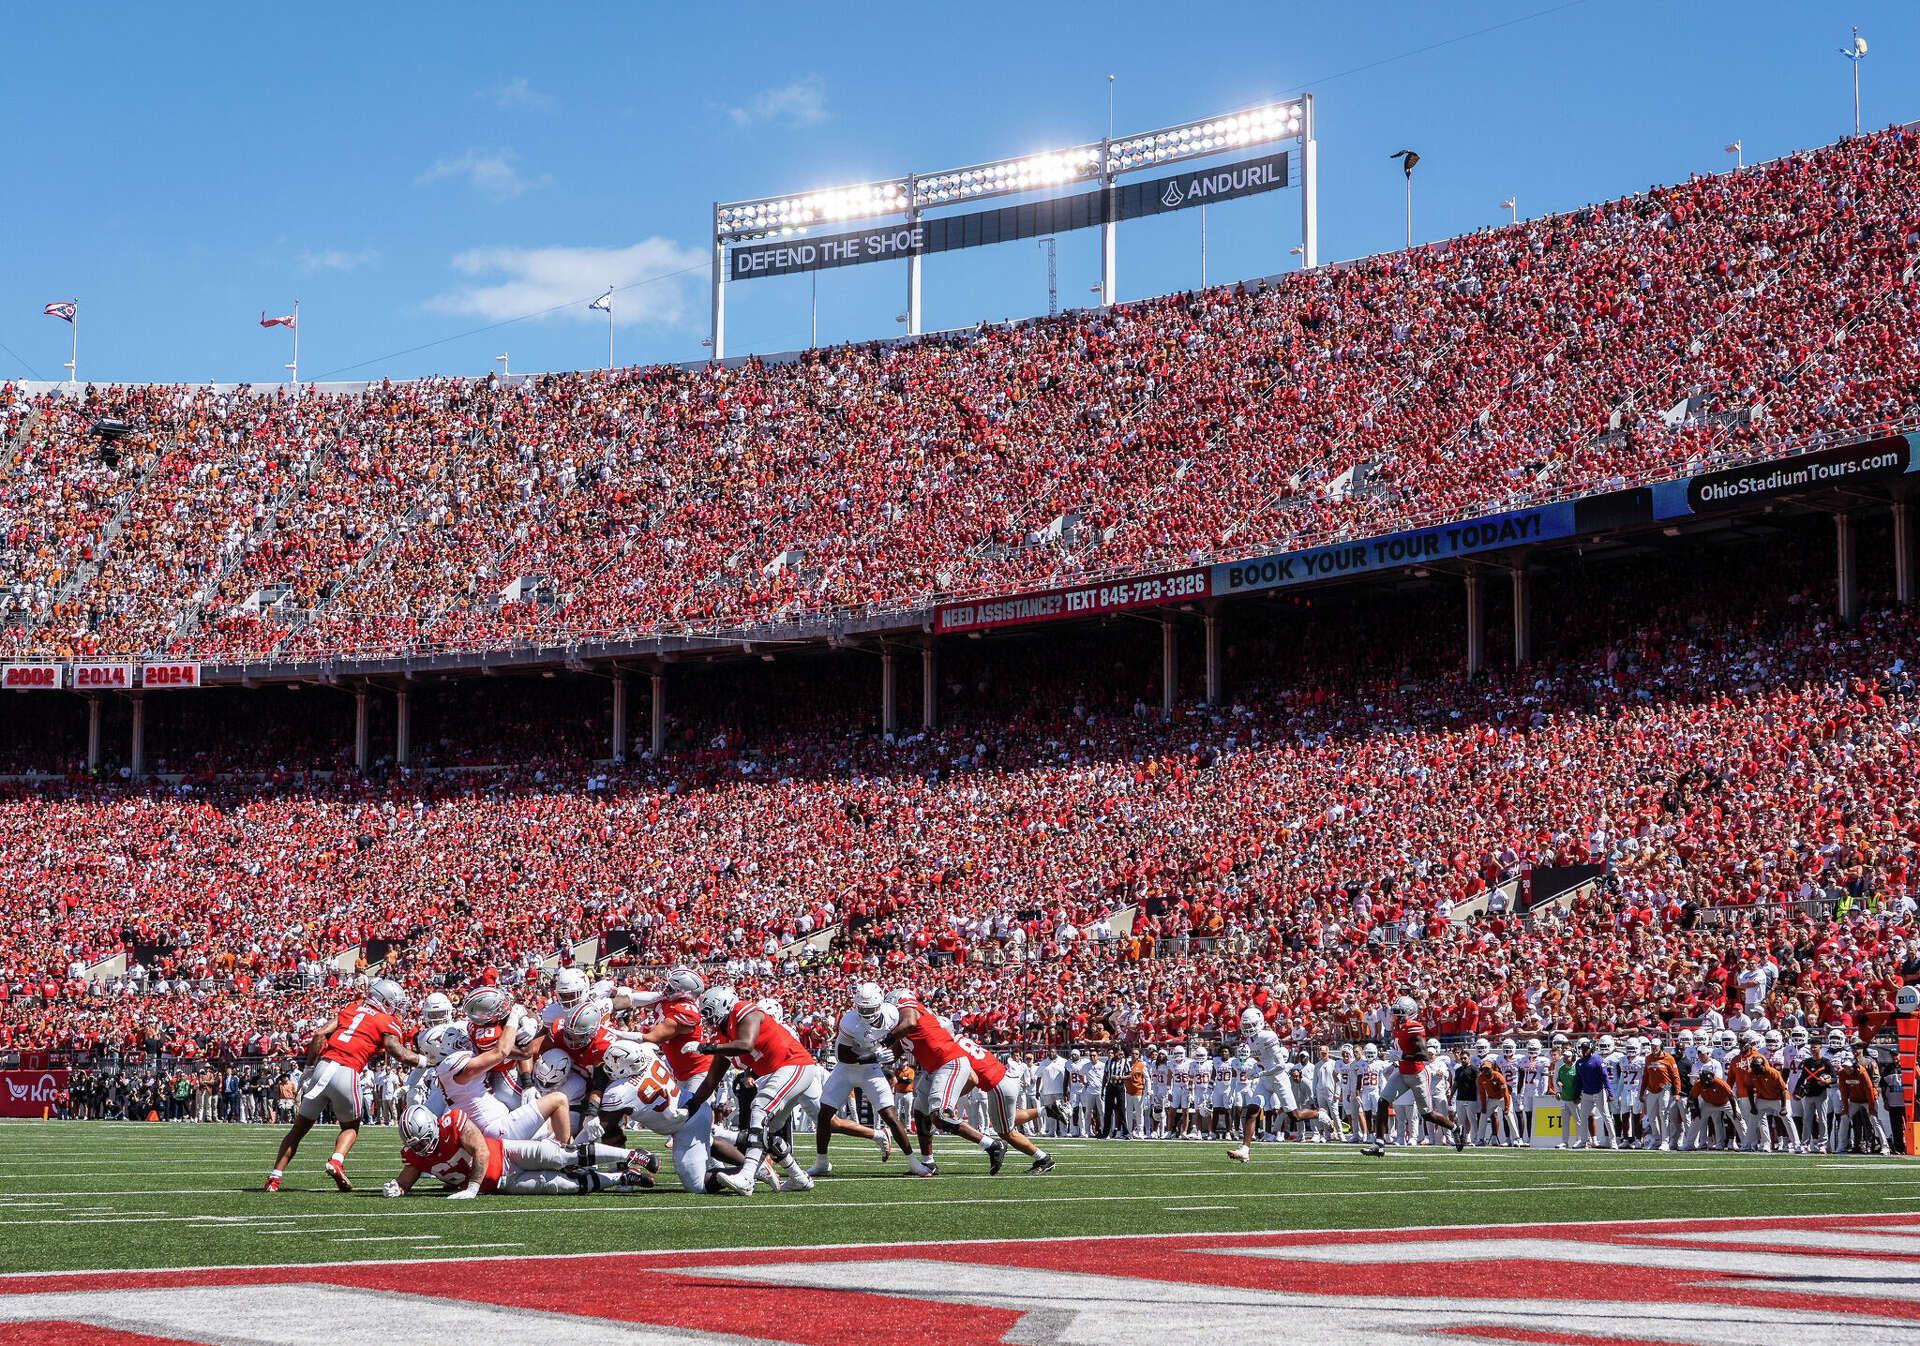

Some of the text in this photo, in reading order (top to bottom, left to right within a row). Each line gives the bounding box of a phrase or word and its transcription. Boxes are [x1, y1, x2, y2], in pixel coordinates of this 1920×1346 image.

[1187, 163, 1280, 200] ANDURIL
[738, 228, 924, 273] DEFEND THE 'SHOE
[1700, 451, 1899, 502] OhioStadiumTours.com
[1229, 513, 1542, 589] BOOK YOUR TOUR TODAY!
[941, 573, 1205, 628] NEED ASSISTANCE? TEXT 845-723-3326
[6, 667, 55, 686] 2002
[77, 667, 126, 685] 2014
[145, 665, 195, 684] 2024
[337, 1013, 366, 1043] 1
[475, 1026, 496, 1040] 20
[637, 1060, 680, 1112] 99
[1525, 1071, 1537, 1084] 17
[1624, 1071, 1639, 1085] 27
